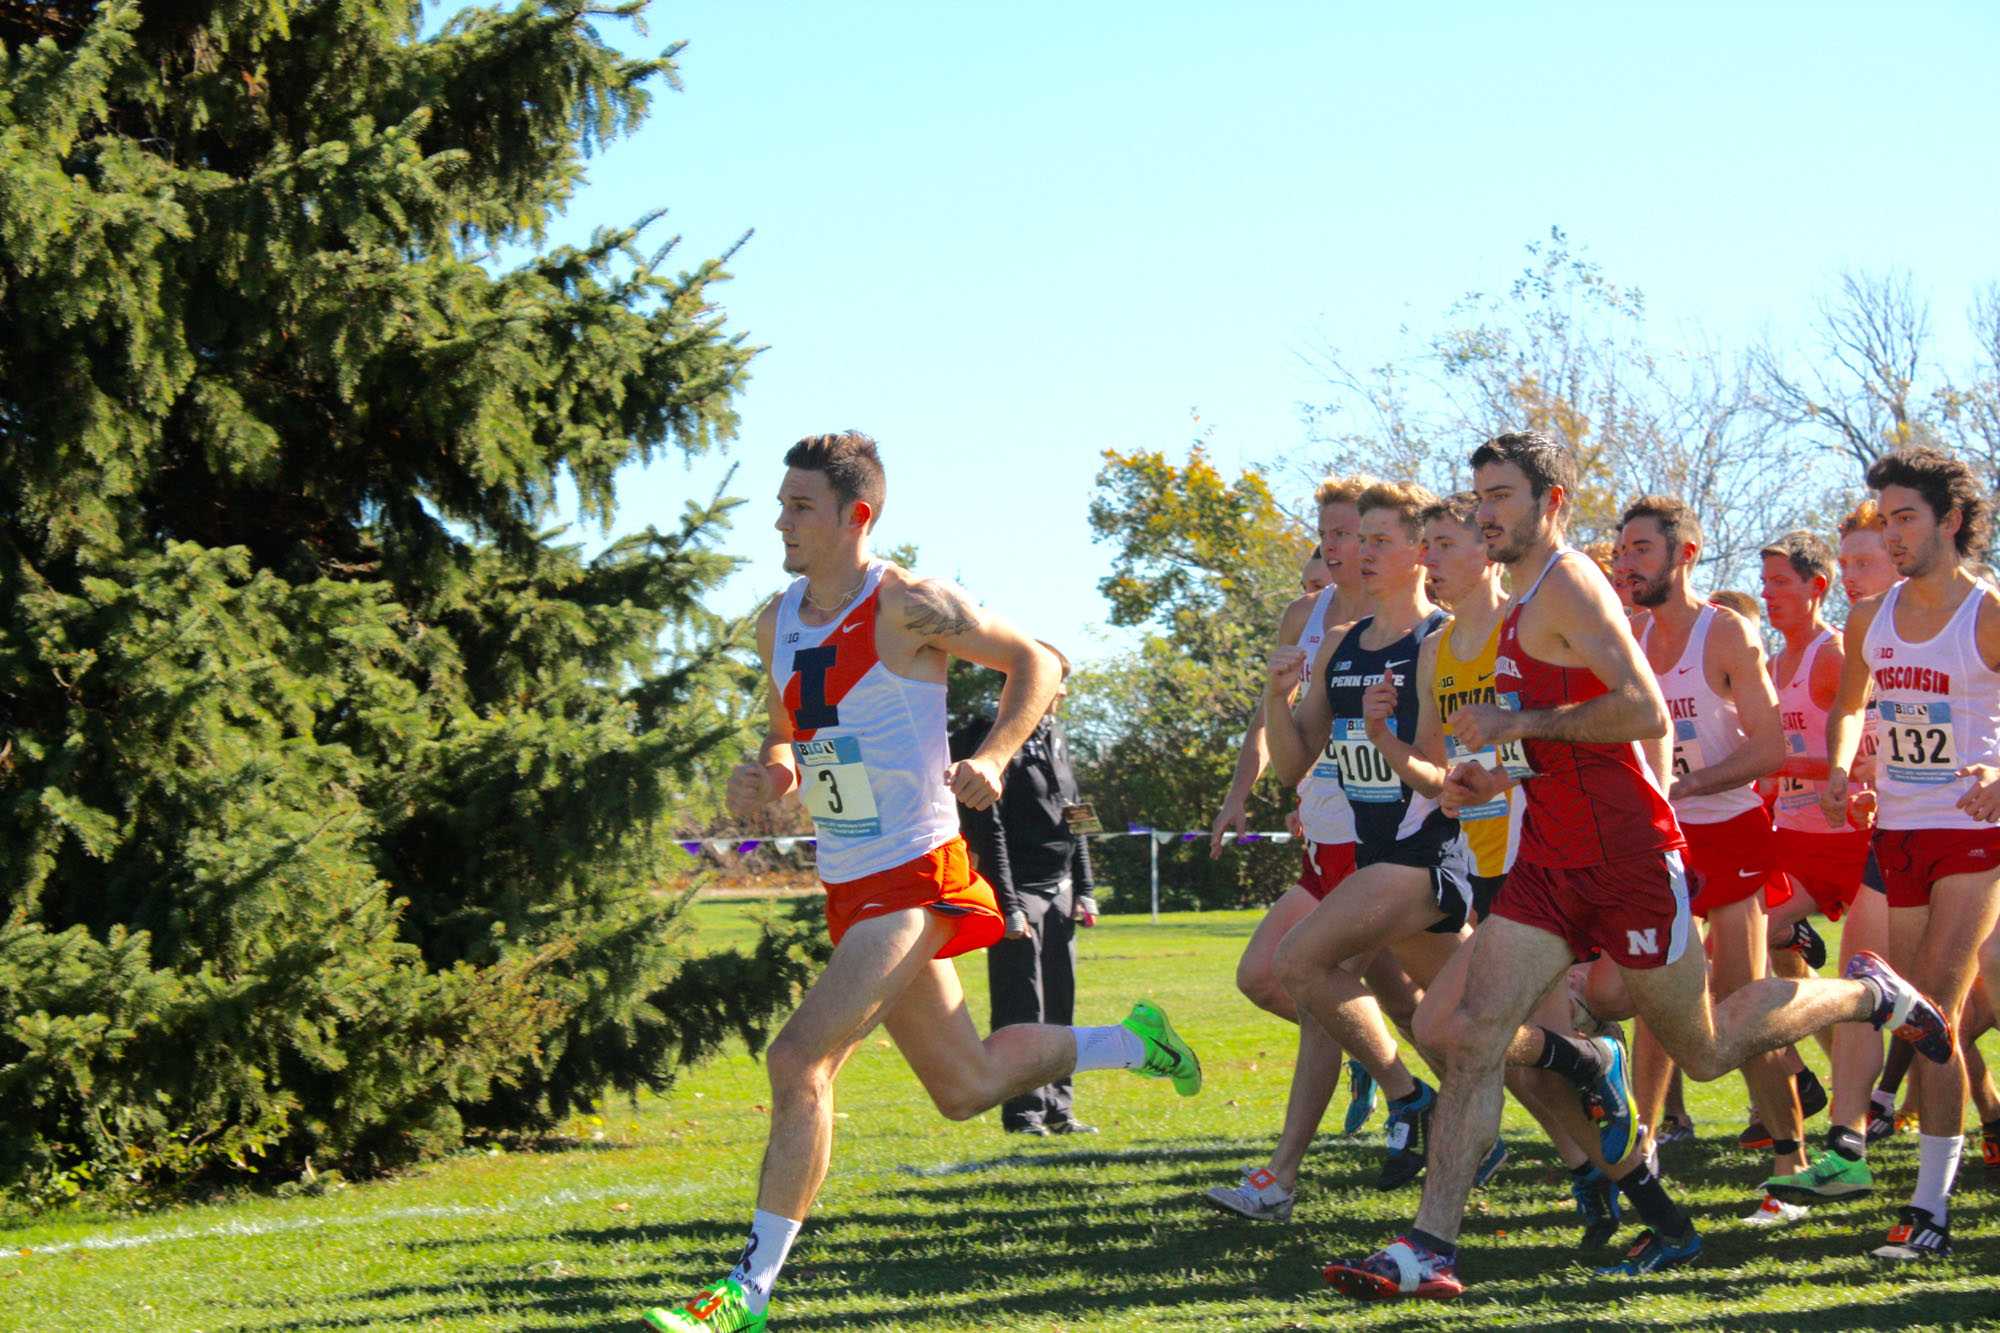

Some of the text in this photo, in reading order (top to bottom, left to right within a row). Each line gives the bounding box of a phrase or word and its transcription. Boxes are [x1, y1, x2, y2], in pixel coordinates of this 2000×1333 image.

[792, 645, 839, 730] I
[1331, 675, 1362, 688] PENN
[1666, 697, 1698, 720] TATE
[1341, 745, 1392, 782] 100
[1888, 727, 1950, 764] 132
[818, 769, 843, 814] 3
[1626, 928, 1660, 955] N
